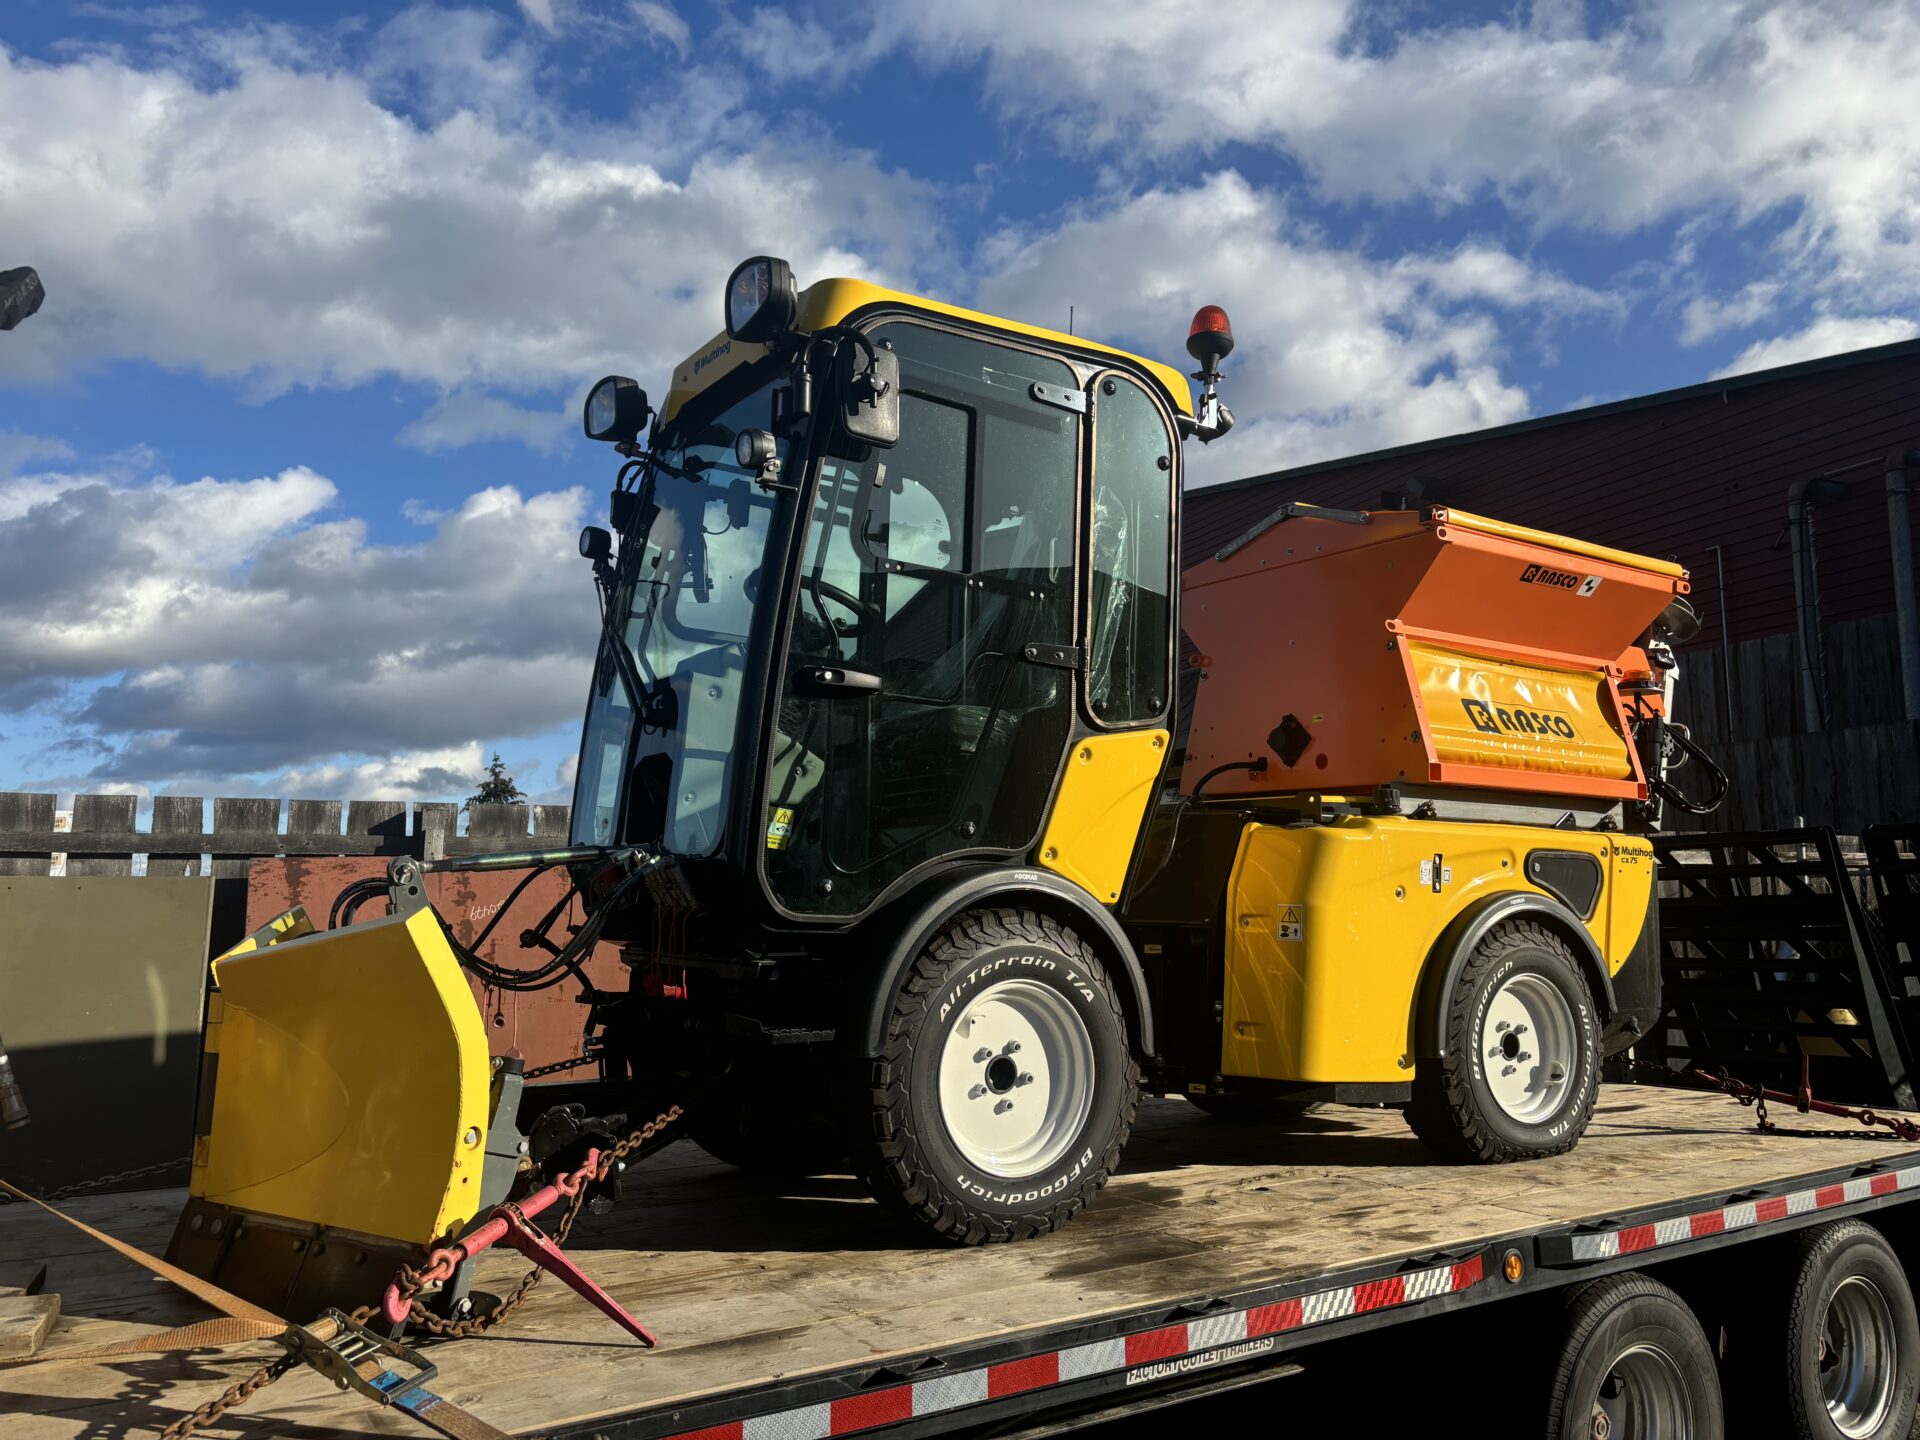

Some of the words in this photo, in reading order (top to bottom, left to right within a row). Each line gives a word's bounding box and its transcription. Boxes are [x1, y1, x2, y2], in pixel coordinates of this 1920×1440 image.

[700, 340, 732, 369] Multihog
[1621, 845, 1653, 861] Multihog
[939, 955, 1056, 1024] All-Terrain
[1065, 969, 1095, 1003] T/A
[1472, 959, 1514, 1080] BFGoodrich
[1570, 1003, 1593, 1117] All-Terrain
[1549, 1120, 1569, 1138] T/A
[956, 1147, 1094, 1206] BFGoodrich
[1127, 1360, 1179, 1384] FACTORY
[1179, 1348, 1221, 1371] OUTLET
[1222, 1337, 1274, 1361] TRAILERS
